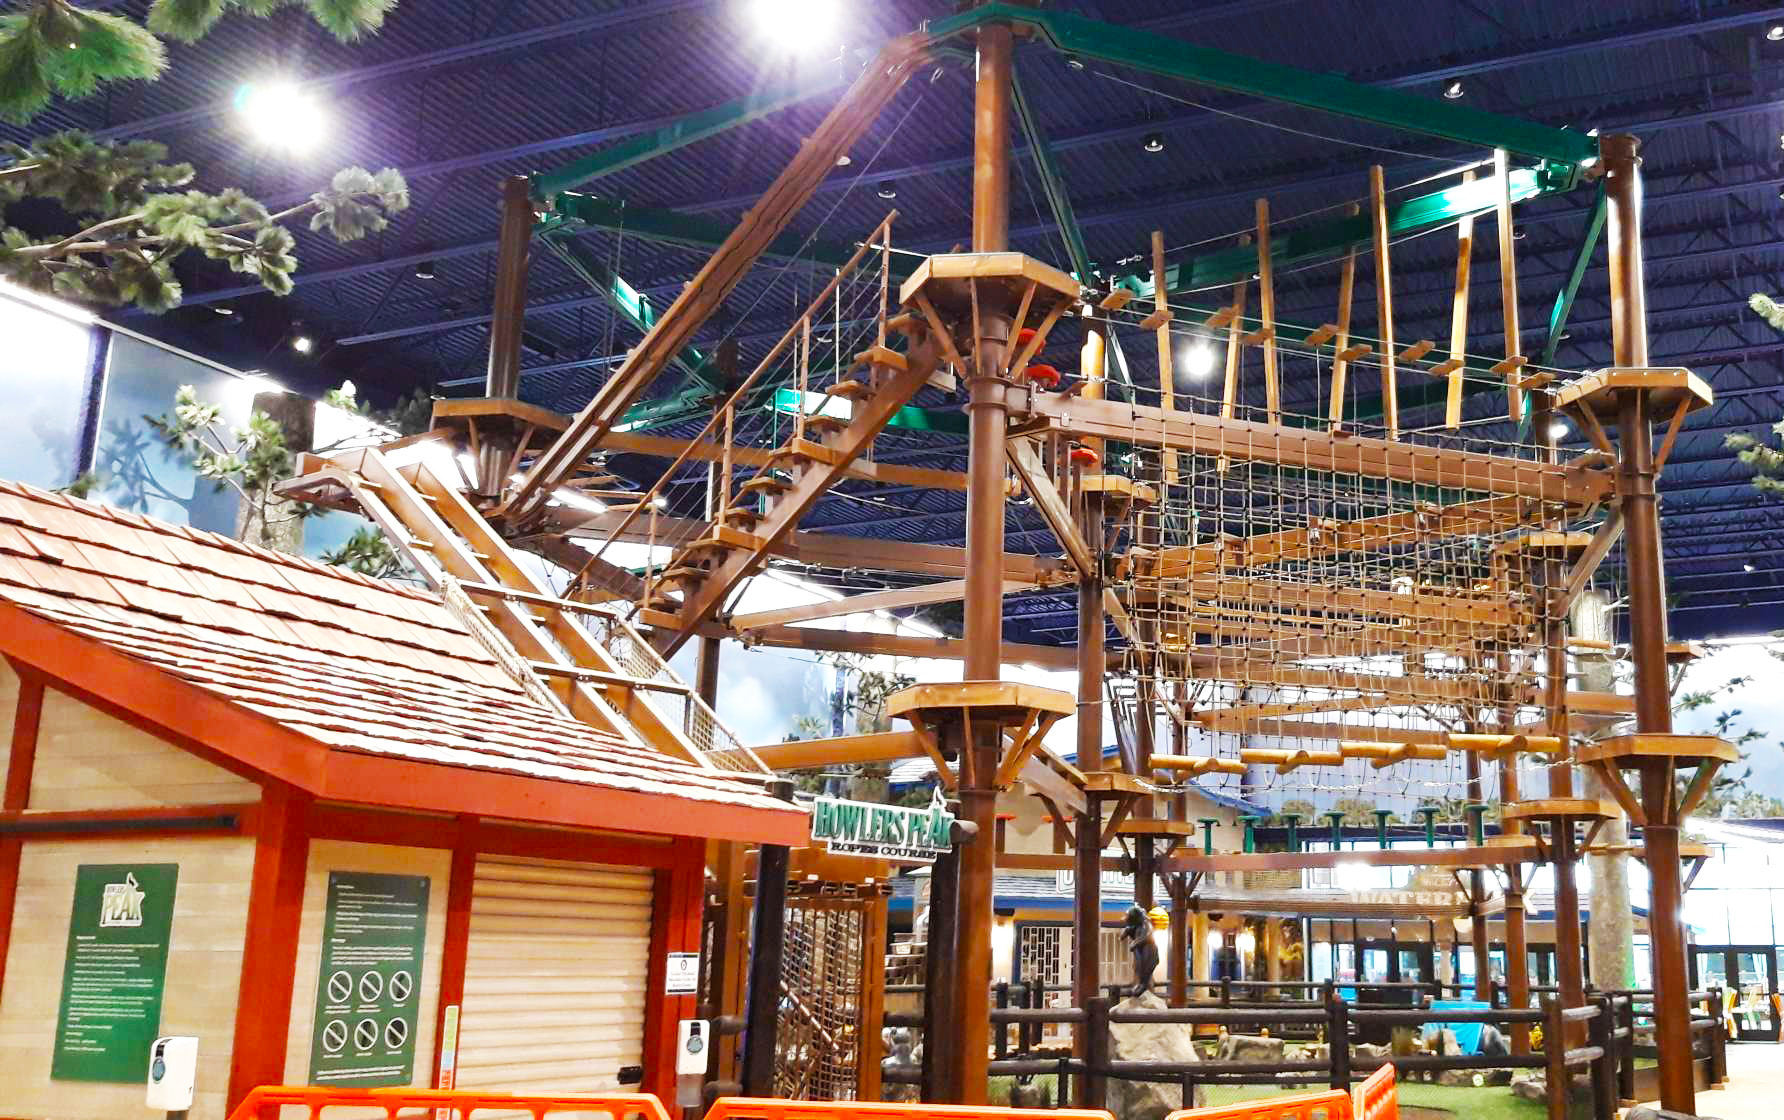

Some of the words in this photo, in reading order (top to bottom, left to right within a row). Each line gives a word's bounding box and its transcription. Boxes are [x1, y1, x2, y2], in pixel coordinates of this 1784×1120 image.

[814, 800, 906, 845] HOWLERS
[906, 805, 955, 850] PEAK
[830, 842, 879, 855] ROPES
[881, 846, 937, 860] COURSE
[1351, 887, 1539, 915] WATERK
